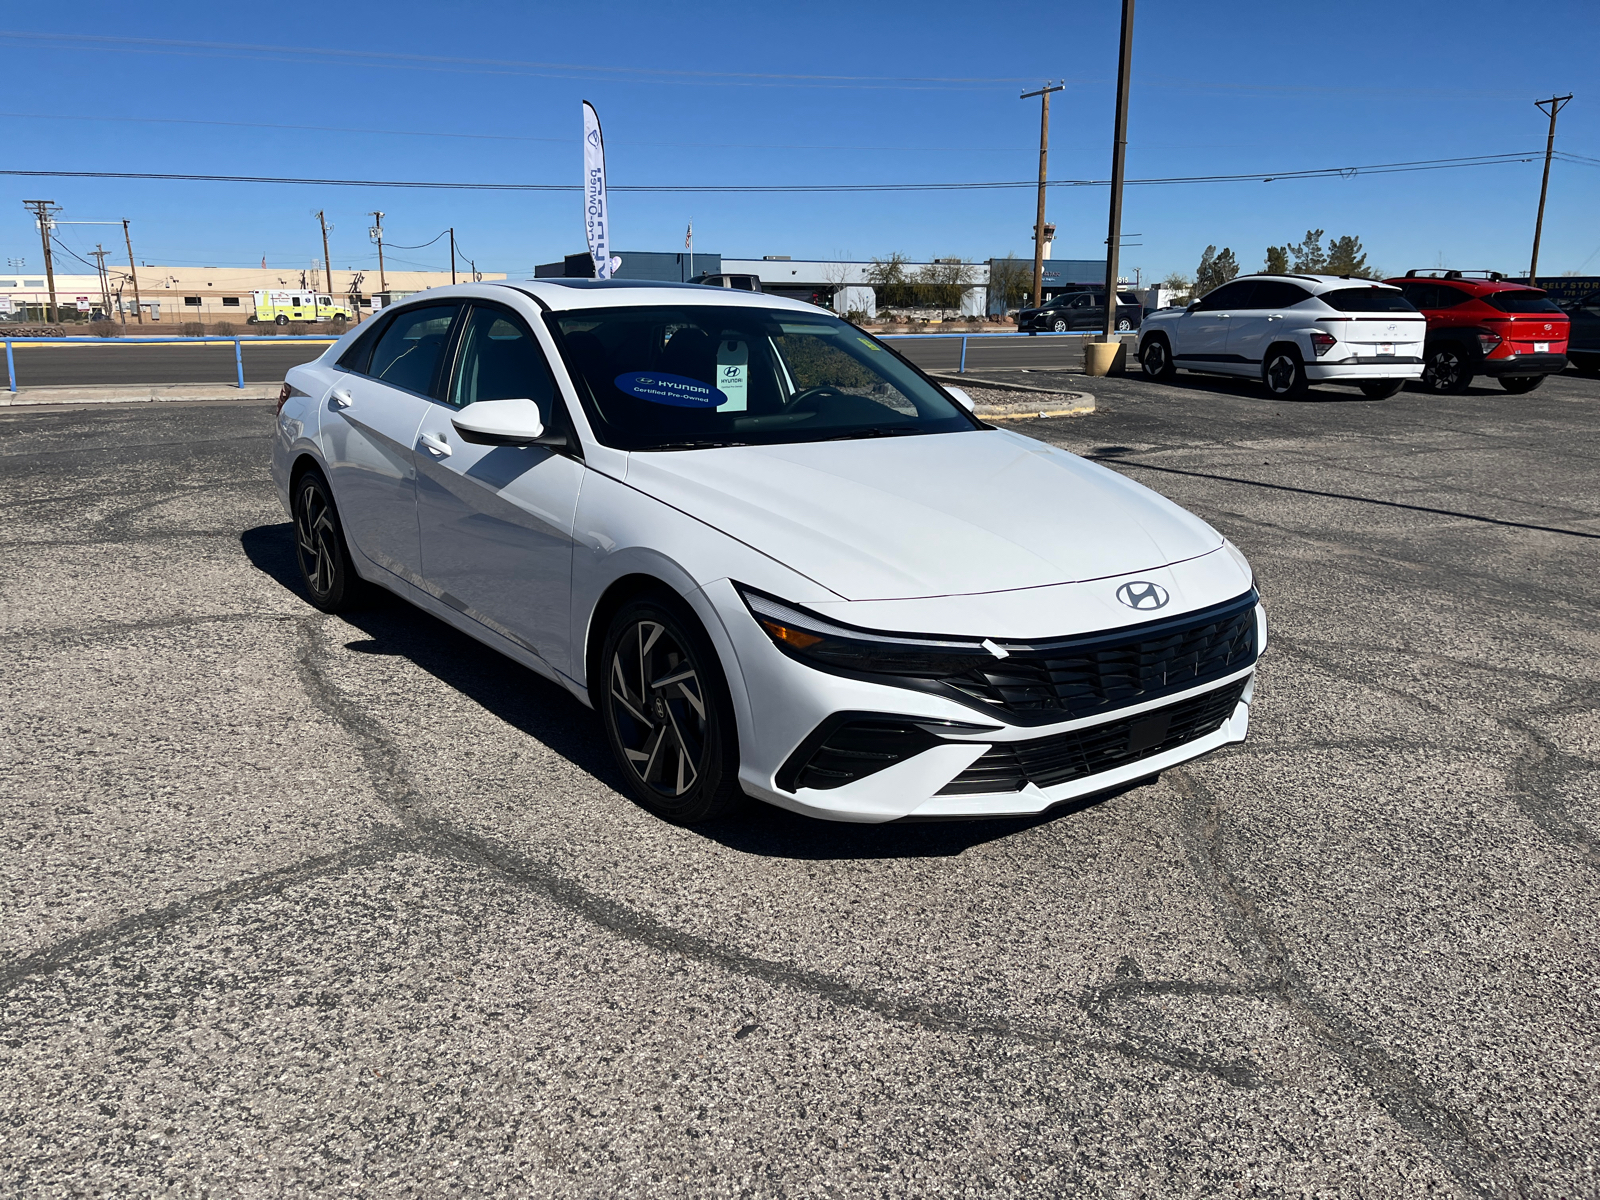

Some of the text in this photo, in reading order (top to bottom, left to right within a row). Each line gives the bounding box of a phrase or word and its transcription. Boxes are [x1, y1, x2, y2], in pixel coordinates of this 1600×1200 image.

[658, 381, 709, 394] HYUNDAI
[634, 387, 709, 403] Certified Pre-Owned
